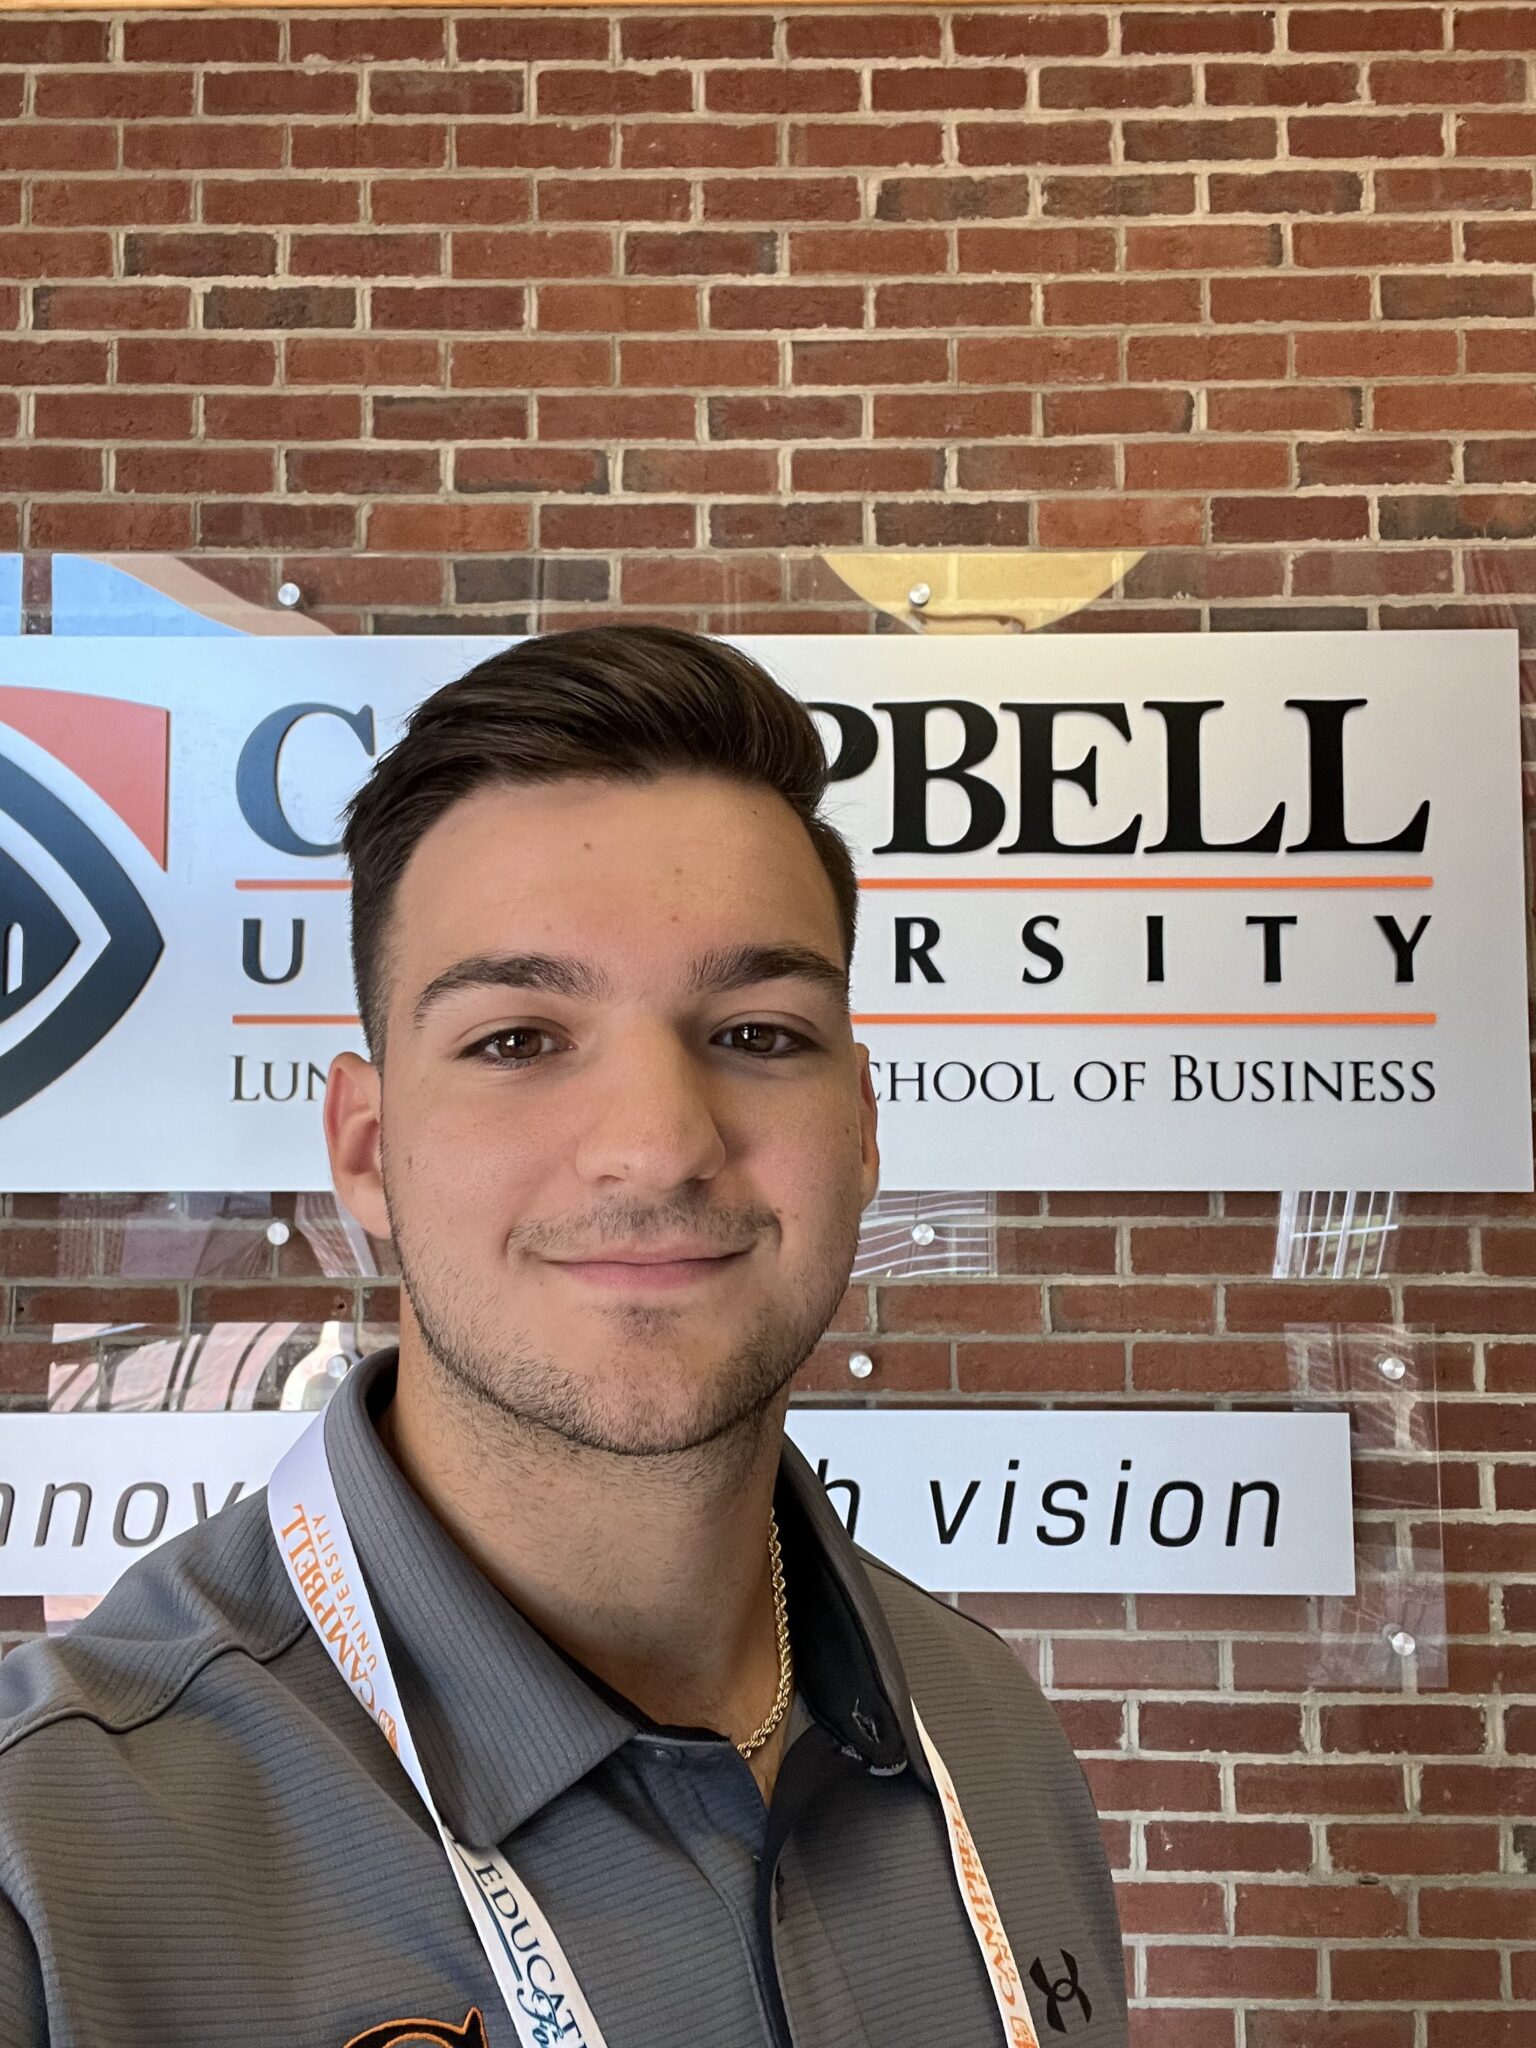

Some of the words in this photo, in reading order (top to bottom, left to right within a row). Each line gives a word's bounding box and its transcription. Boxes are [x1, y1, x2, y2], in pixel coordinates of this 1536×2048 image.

[236, 699, 1431, 856] CPBELL
[242, 914, 1432, 985] URSITY
[1074, 1060, 1146, 1102] OF
[1171, 1054, 1437, 1103] BUSINESS
[929, 1459, 1281, 1548] vision
[281, 1503, 375, 1711] CAMPBELL
[312, 1513, 378, 1673] UNIVERSITY
[474, 1862, 588, 2048] EDUCAT
